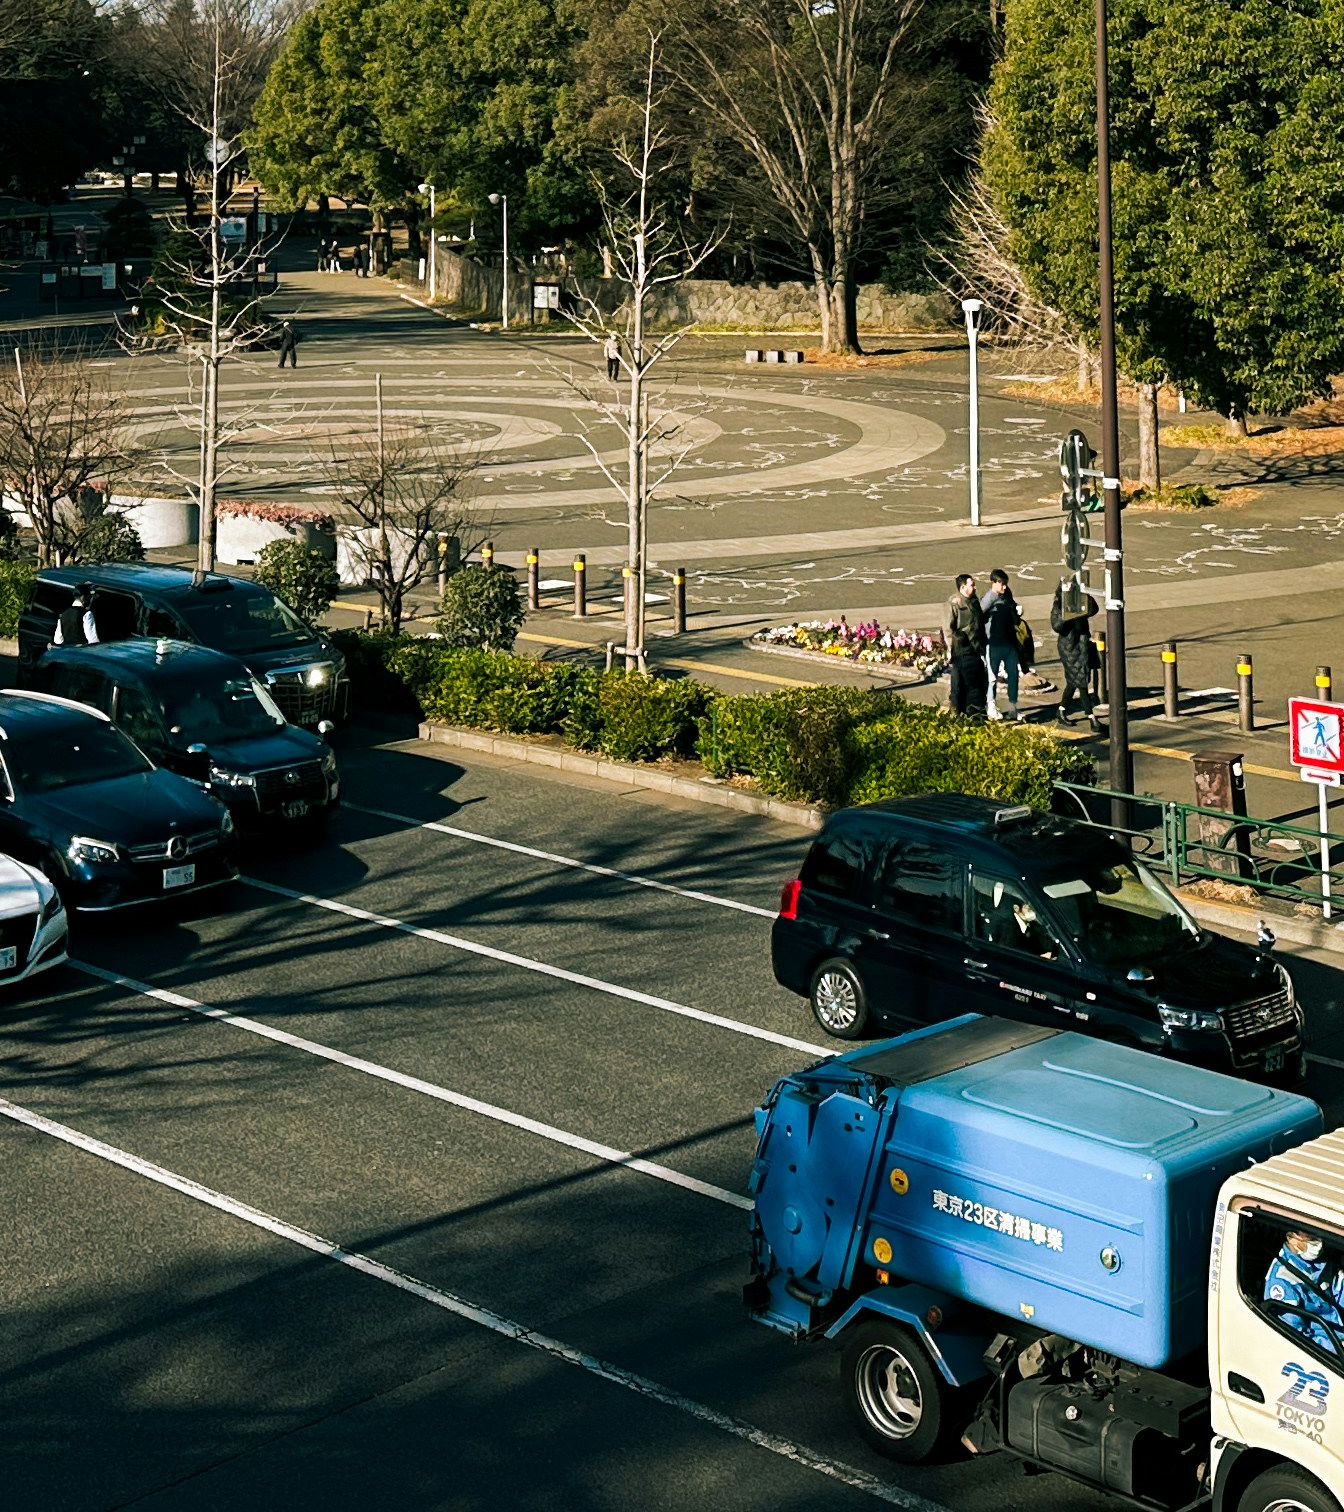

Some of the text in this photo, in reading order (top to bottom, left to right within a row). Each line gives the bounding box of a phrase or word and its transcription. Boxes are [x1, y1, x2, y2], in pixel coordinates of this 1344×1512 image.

[932, 1189, 1064, 1253] 東京23区清掃事業
[1276, 1361, 1330, 1417] 23
[1275, 1402, 1326, 1433] TOKYO
